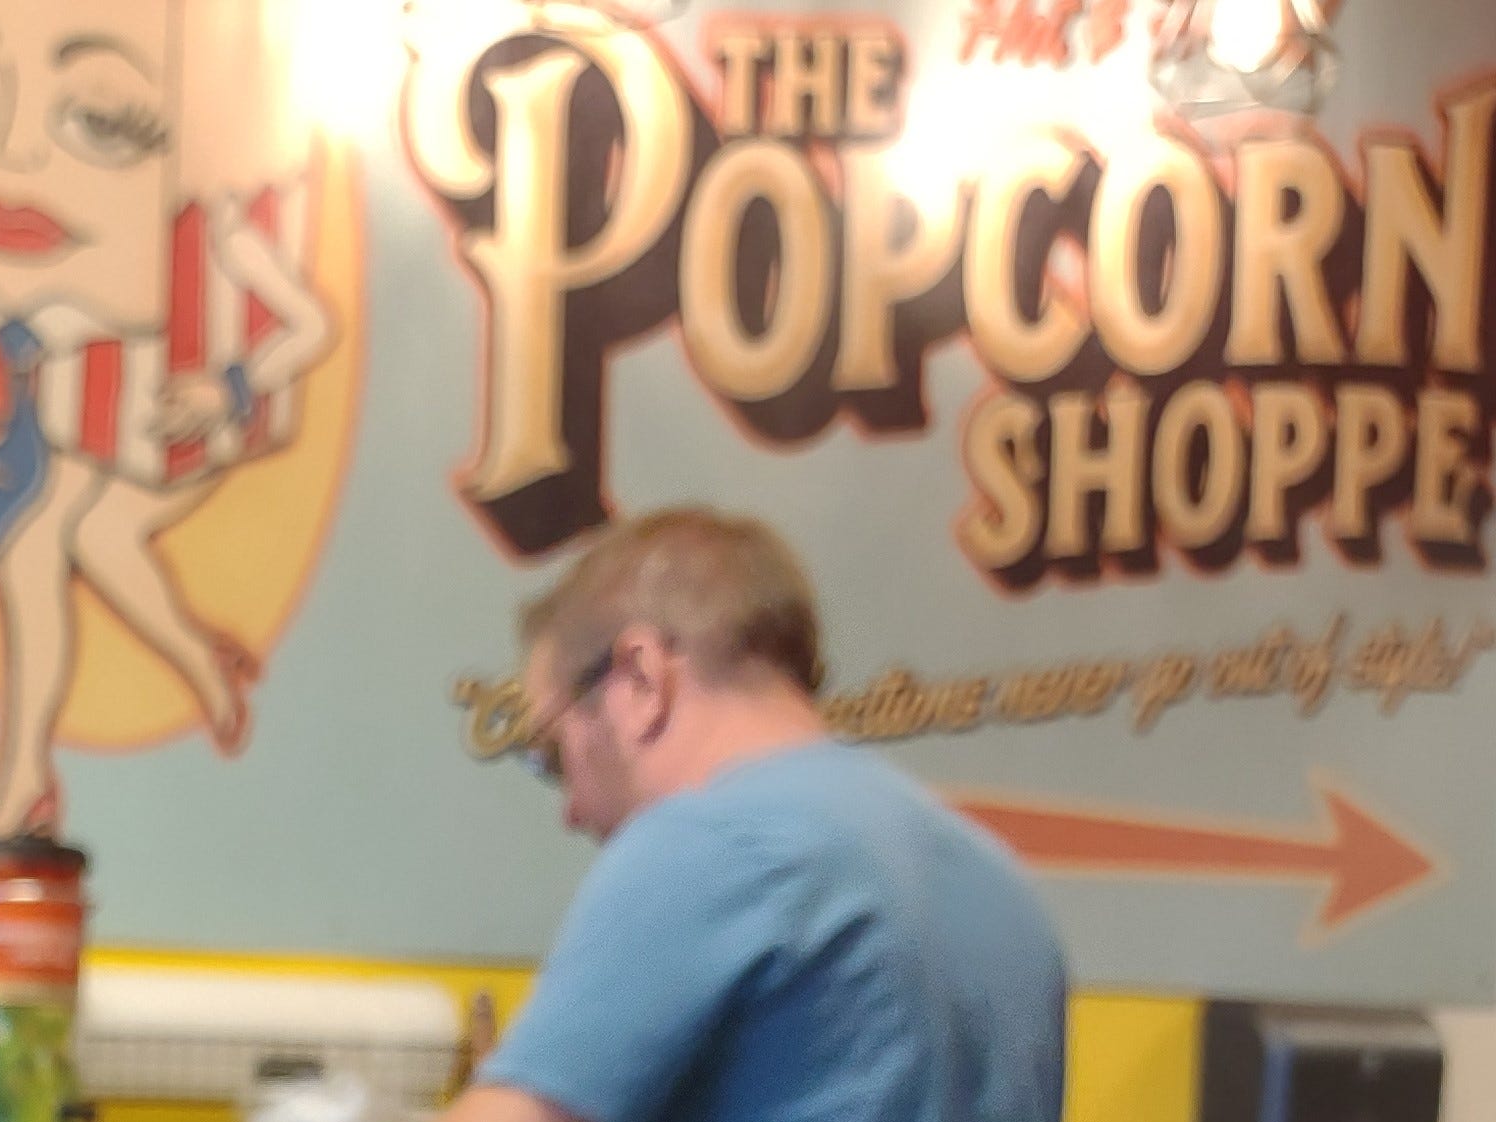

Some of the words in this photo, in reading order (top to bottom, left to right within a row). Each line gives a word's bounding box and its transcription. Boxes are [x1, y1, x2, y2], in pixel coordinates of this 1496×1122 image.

[712, 22, 904, 142] THE
[399, 2, 1496, 562] POPCORN
[956, 378, 1488, 594] SHOPPE
